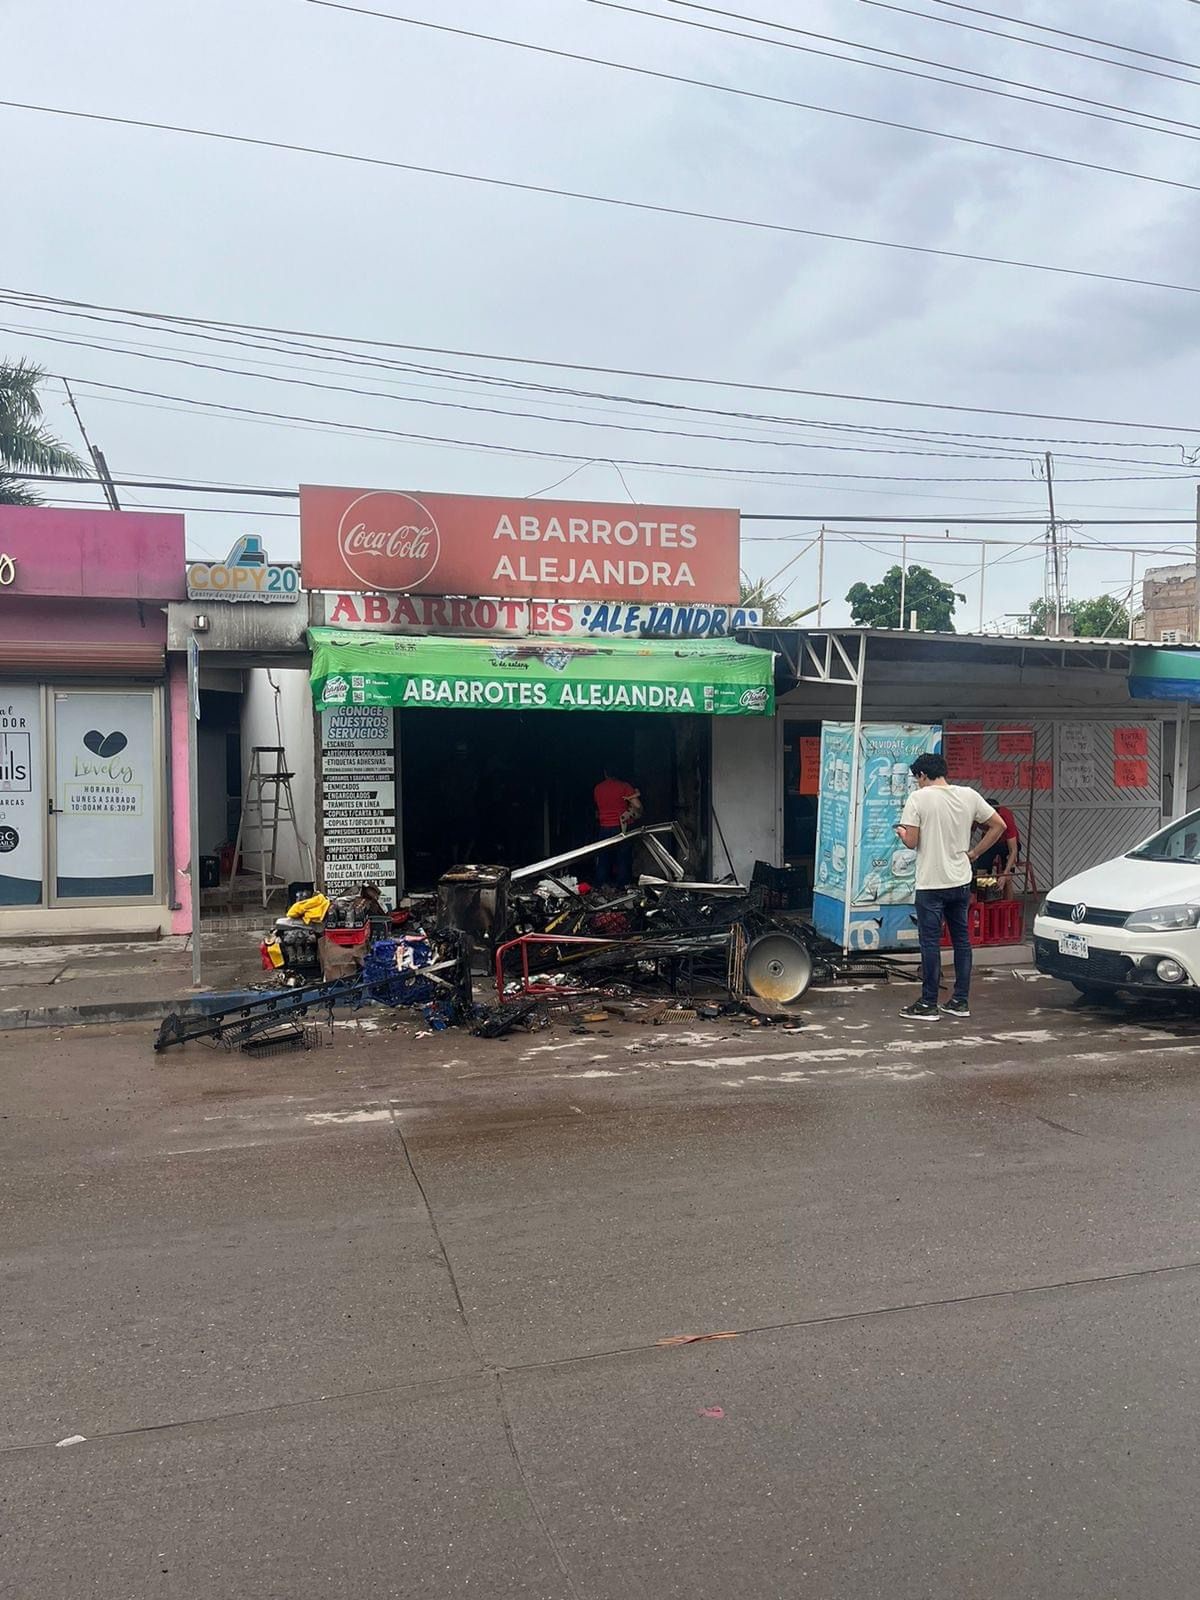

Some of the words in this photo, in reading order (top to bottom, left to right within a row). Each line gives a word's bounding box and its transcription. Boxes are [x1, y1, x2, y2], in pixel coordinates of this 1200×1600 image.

[344, 522, 434, 559] Coca-Cola
[493, 515, 697, 549] ABARROTES
[492, 555, 696, 587] ALEJANDRA
[224, 592, 251, 602] copiado
[258, 592, 297, 602] impresiones
[330, 594, 574, 632] ABARROTES
[403, 679, 547, 704] ABARROTES
[559, 684, 695, 707] ALEJANDRA
[339, 706, 384, 716] CONOCE
[331, 716, 388, 727] NUESTROS
[328, 728, 388, 739] SERVICIOS:
[73, 753, 133, 783] Lovely
[71, 795, 97, 803] LUNES
[105, 796, 136, 804] SABADO
[364, 870, 395, 878] (ADHESIVO)
